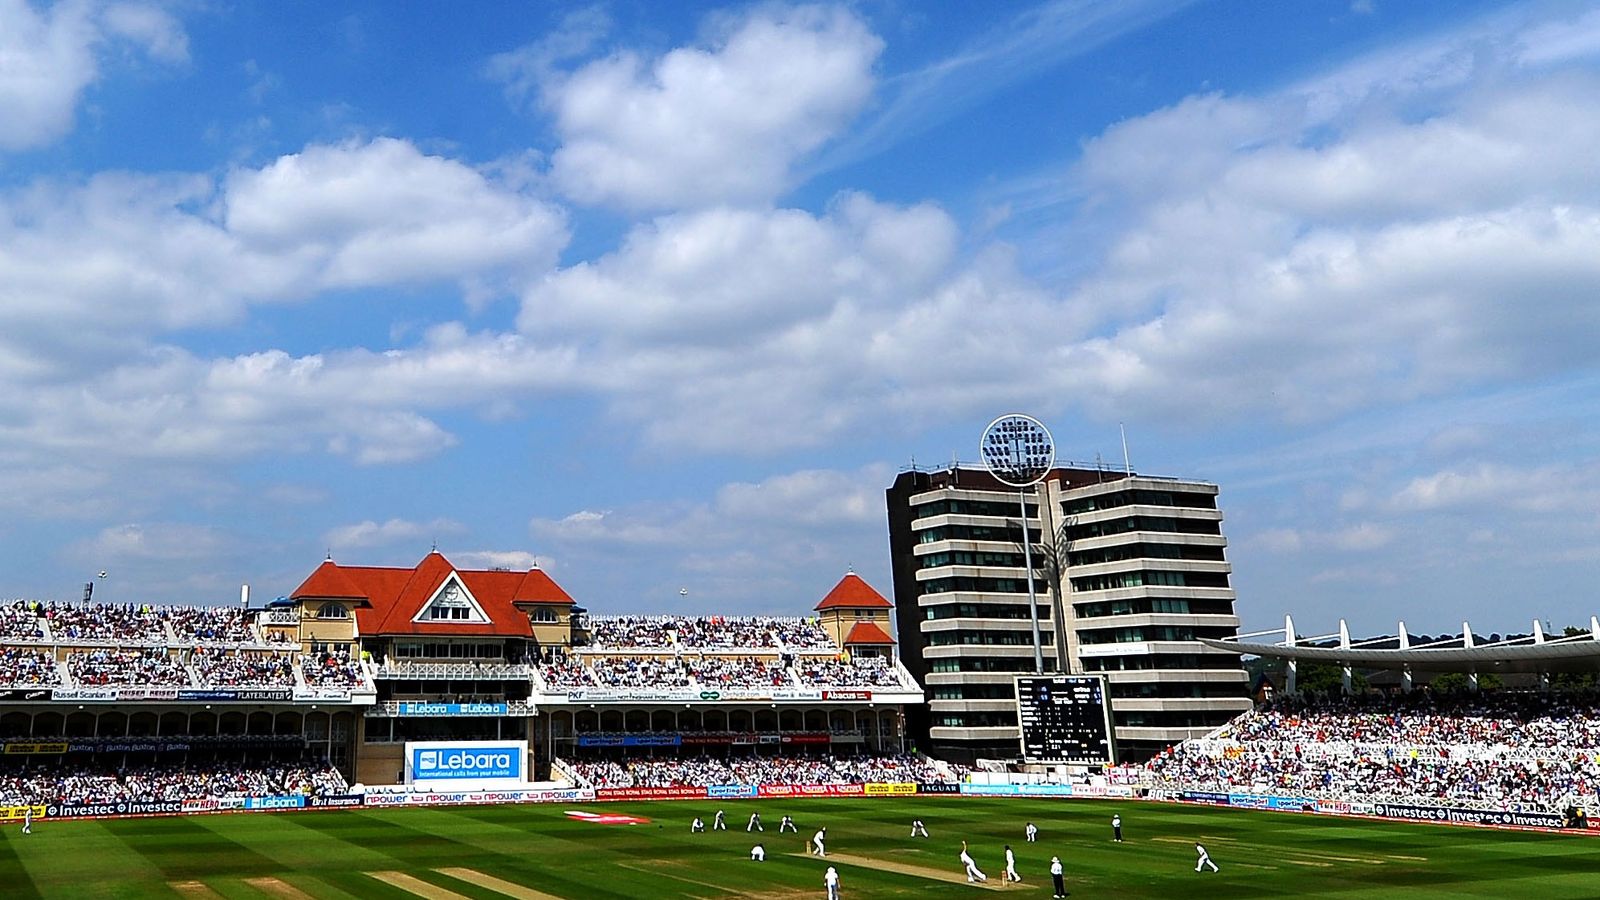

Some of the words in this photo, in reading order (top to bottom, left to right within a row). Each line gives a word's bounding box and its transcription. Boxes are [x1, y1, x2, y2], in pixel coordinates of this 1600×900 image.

[53, 690, 78, 699] Russell
[79, 690, 106, 699] Scanlan
[568, 691, 584, 699] PKF
[826, 691, 857, 700] Abacus
[415, 703, 447, 713] Lebara
[467, 703, 500, 713] Lebara
[438, 750, 510, 769] Lebara
[366, 795, 408, 804] npower
[426, 794, 467, 802] npower
[484, 792, 524, 801] npower
[541, 791, 579, 799] npower
[200, 800, 220, 809] HERO
[261, 796, 298, 807] Lebara
[327, 797, 360, 806] Insurance
[1232, 797, 1268, 806] sportingbet
[60, 803, 115, 816] Investec
[128, 801, 181, 813] Investec
[1385, 804, 1436, 820] Investec
[1447, 808, 1501, 824] Investec
[1511, 813, 1562, 828] Investec
